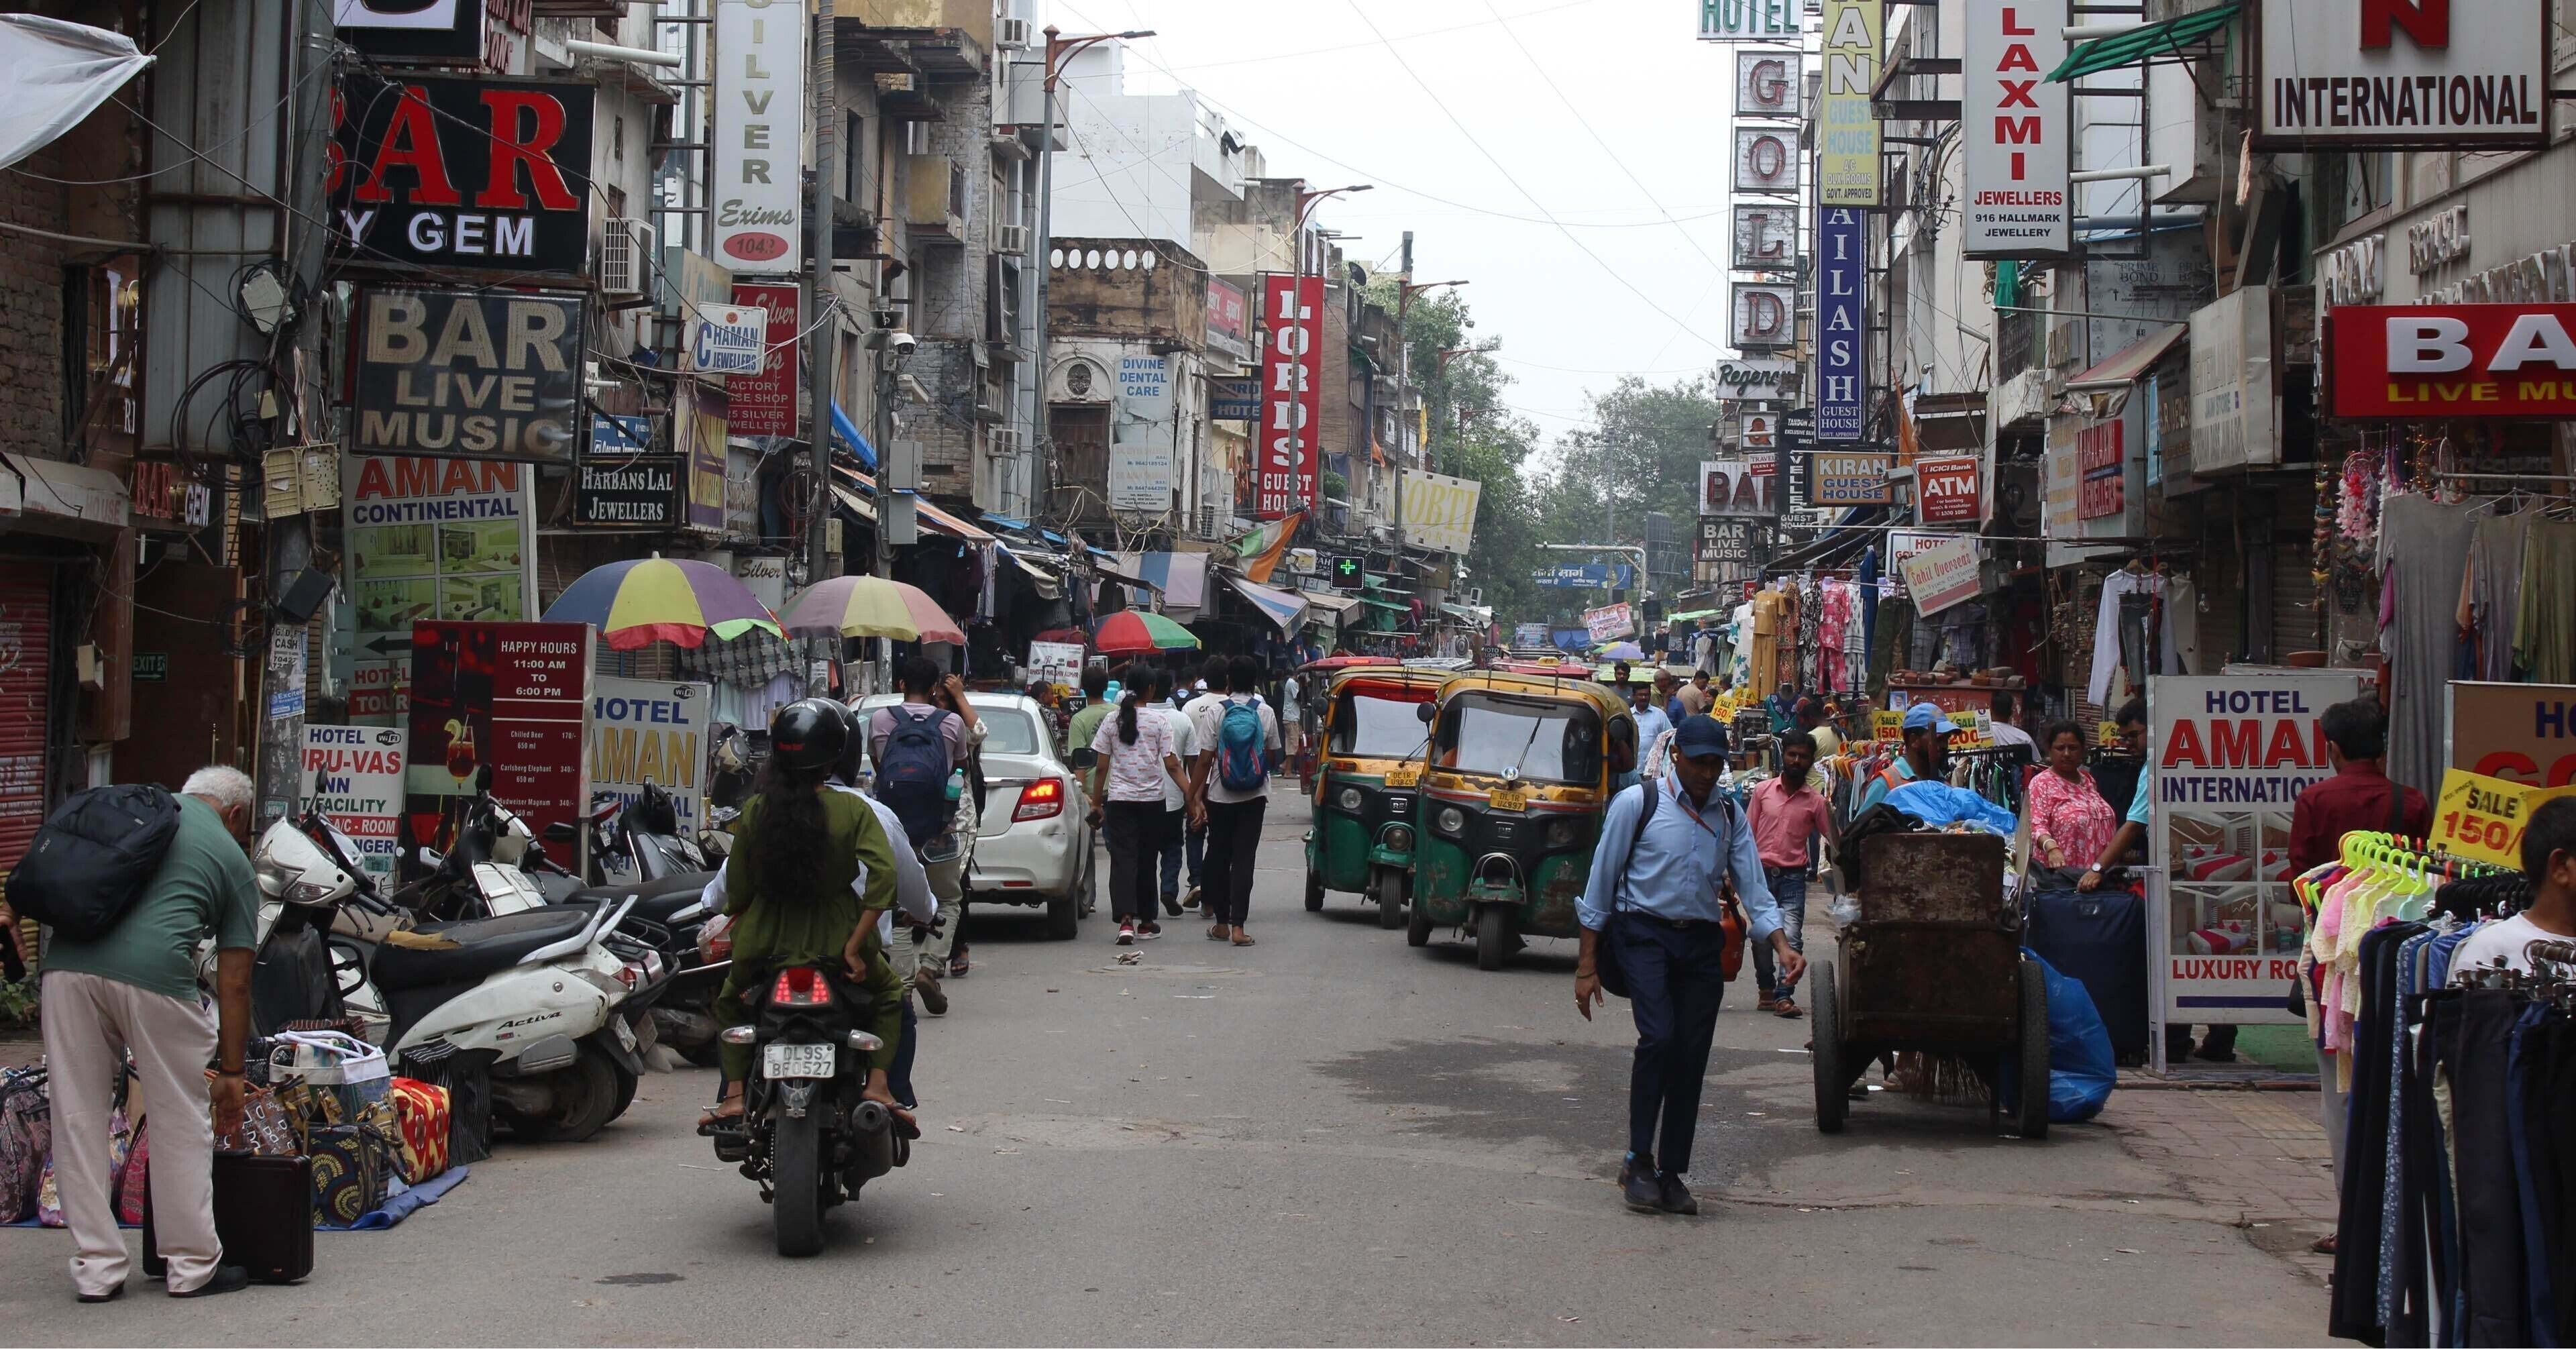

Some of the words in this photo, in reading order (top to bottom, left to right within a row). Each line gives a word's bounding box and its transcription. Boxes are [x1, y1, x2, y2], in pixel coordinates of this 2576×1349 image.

[1828, 7, 1872, 95] AN
[1994, 8, 2041, 180] LAXMI
[2274, 74, 2538, 127] INTERNATIONAL
[1828, 131, 1872, 155] HOUSE
[1843, 160, 1857, 172] A/C
[1845, 173, 1872, 184] ROOMS
[1744, 60, 1789, 336] GOLD
[1826, 188, 1843, 199] GOVT.
[1844, 188, 1872, 199] APPROVED
[1974, 191, 2062, 207] JEWELLERS
[718, 199, 795, 227] Exims
[1975, 213, 1996, 223] 916
[1998, 213, 2061, 223] HALLMARK
[409, 211, 533, 256] GEM
[1984, 228, 2051, 237] JEWELLERY
[2121, 272, 2159, 282] BOND
[367, 294, 567, 372] BAR
[2386, 313, 2576, 373] BA
[712, 352, 757, 371] JEWELLERS
[1122, 359, 1165, 370] DIVINE
[1120, 372, 1167, 383] DENTAL
[1273, 290, 1311, 467] LORDS
[1718, 364, 1791, 396] Regenc
[396, 370, 535, 411] LIVE
[755, 394, 789, 403] SHOP
[1126, 386, 1160, 396] CARE
[2387, 382, 2499, 402] LIVE
[742, 410, 784, 419] SILVER
[1218, 404, 1260, 417] HOTE
[1822, 406, 1858, 417] GUEST
[360, 410, 564, 454] MUSIC
[729, 420, 788, 431] WELLERY
[1821, 419, 1860, 429] HOUSE
[1819, 458, 1887, 476] KIRAN
[1930, 464, 1950, 472] ICICI
[1951, 463, 1972, 471] Bank
[354, 457, 519, 500] AMAN
[582, 466, 645, 491] HARBANS
[1823, 478, 1883, 488] GUEST
[1924, 475, 1976, 498] ATM
[1263, 494, 1311, 511] HOE
[1822, 490, 1884, 499] HOUSE
[353, 497, 519, 524] CONTINENTAL
[589, 496, 664, 521] JEWELLERS
[1413, 527, 1465, 547] PORTS
[1704, 524, 1745, 538] BAR
[1709, 539, 1740, 549] LIVE
[1915, 539, 1950, 550] HOTE
[1702, 549, 1748, 559] MUSIC
[739, 559, 782, 579] Silver
[1911, 566, 1933, 586] Sahil
[1933, 552, 1971, 578] Overseas
[274, 638, 299, 650] CASH
[501, 641, 537, 653] HAPPY
[540, 642, 577, 654] HOURS
[513, 659, 544, 668] 11:00
[547, 661, 566, 669] AM
[355, 667, 411, 684] HOTL
[531, 673, 547, 682] TO
[516, 687, 540, 696] 6:00
[544, 688, 561, 696] PM
[2206, 690, 2310, 714] HOTEL
[594, 697, 689, 724] HOTEL
[1881, 716, 1897, 726] SALE
[309, 728, 365, 744] HOTEL
[511, 731, 530, 739] Chilled
[1876, 726, 1901, 739] 150/
[500, 763, 527, 772] Carlsberg
[528, 765, 551, 773] Elephant
[325, 777, 351, 794] NN
[313, 797, 386, 813] FACILITY
[528, 798, 551, 806] Magnum
[2466, 787, 2518, 820] SALE
[361, 820, 396, 834] ROOM
[2443, 810, 2526, 857] 150/
[354, 839, 394, 854] NGER
[2172, 959, 2262, 979] LUXURY
[2269, 959, 2298, 980] RO
[496, 1011, 563, 1031] Activa
